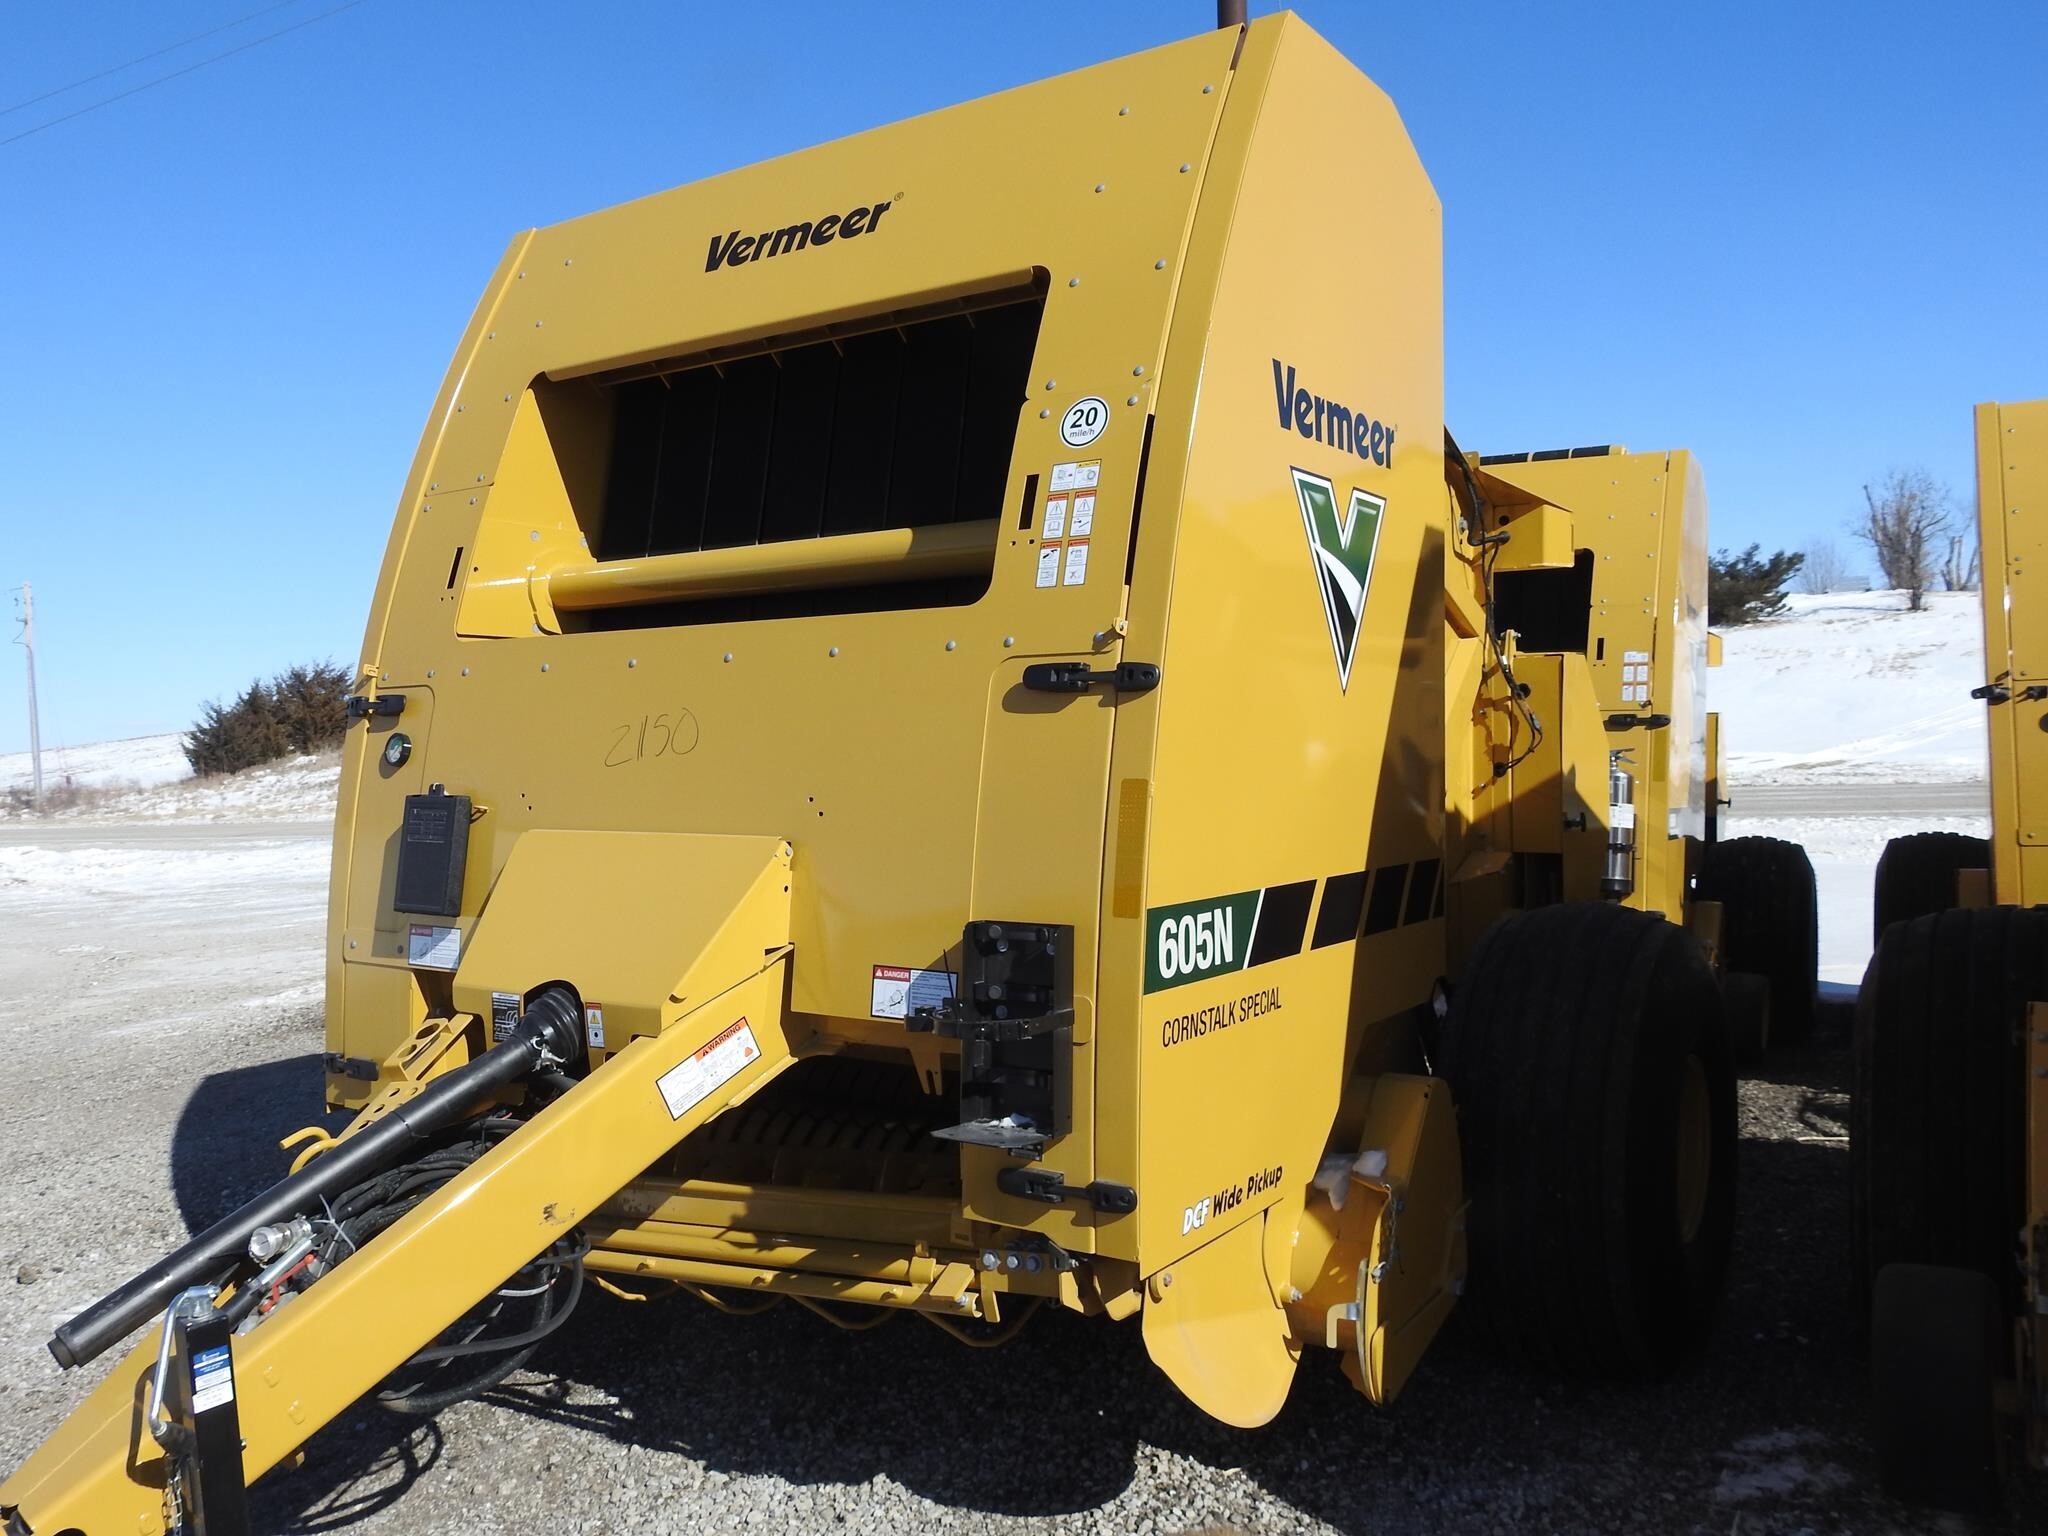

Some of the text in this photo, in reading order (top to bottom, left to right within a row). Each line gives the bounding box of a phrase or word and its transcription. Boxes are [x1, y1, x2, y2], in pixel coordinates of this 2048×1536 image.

[705, 201, 892, 273] Vermeer
[1070, 406, 1098, 428] 20
[1272, 358, 1394, 469] Vermeer
[884, 970, 909, 979] DANGER
[1159, 906, 1233, 978] 605N
[708, 1024, 740, 1052] WARNING
[1162, 986, 1282, 1048] CORNSTALK SPECIAL
[1182, 1165, 1283, 1236] DCF Wide Pickup
